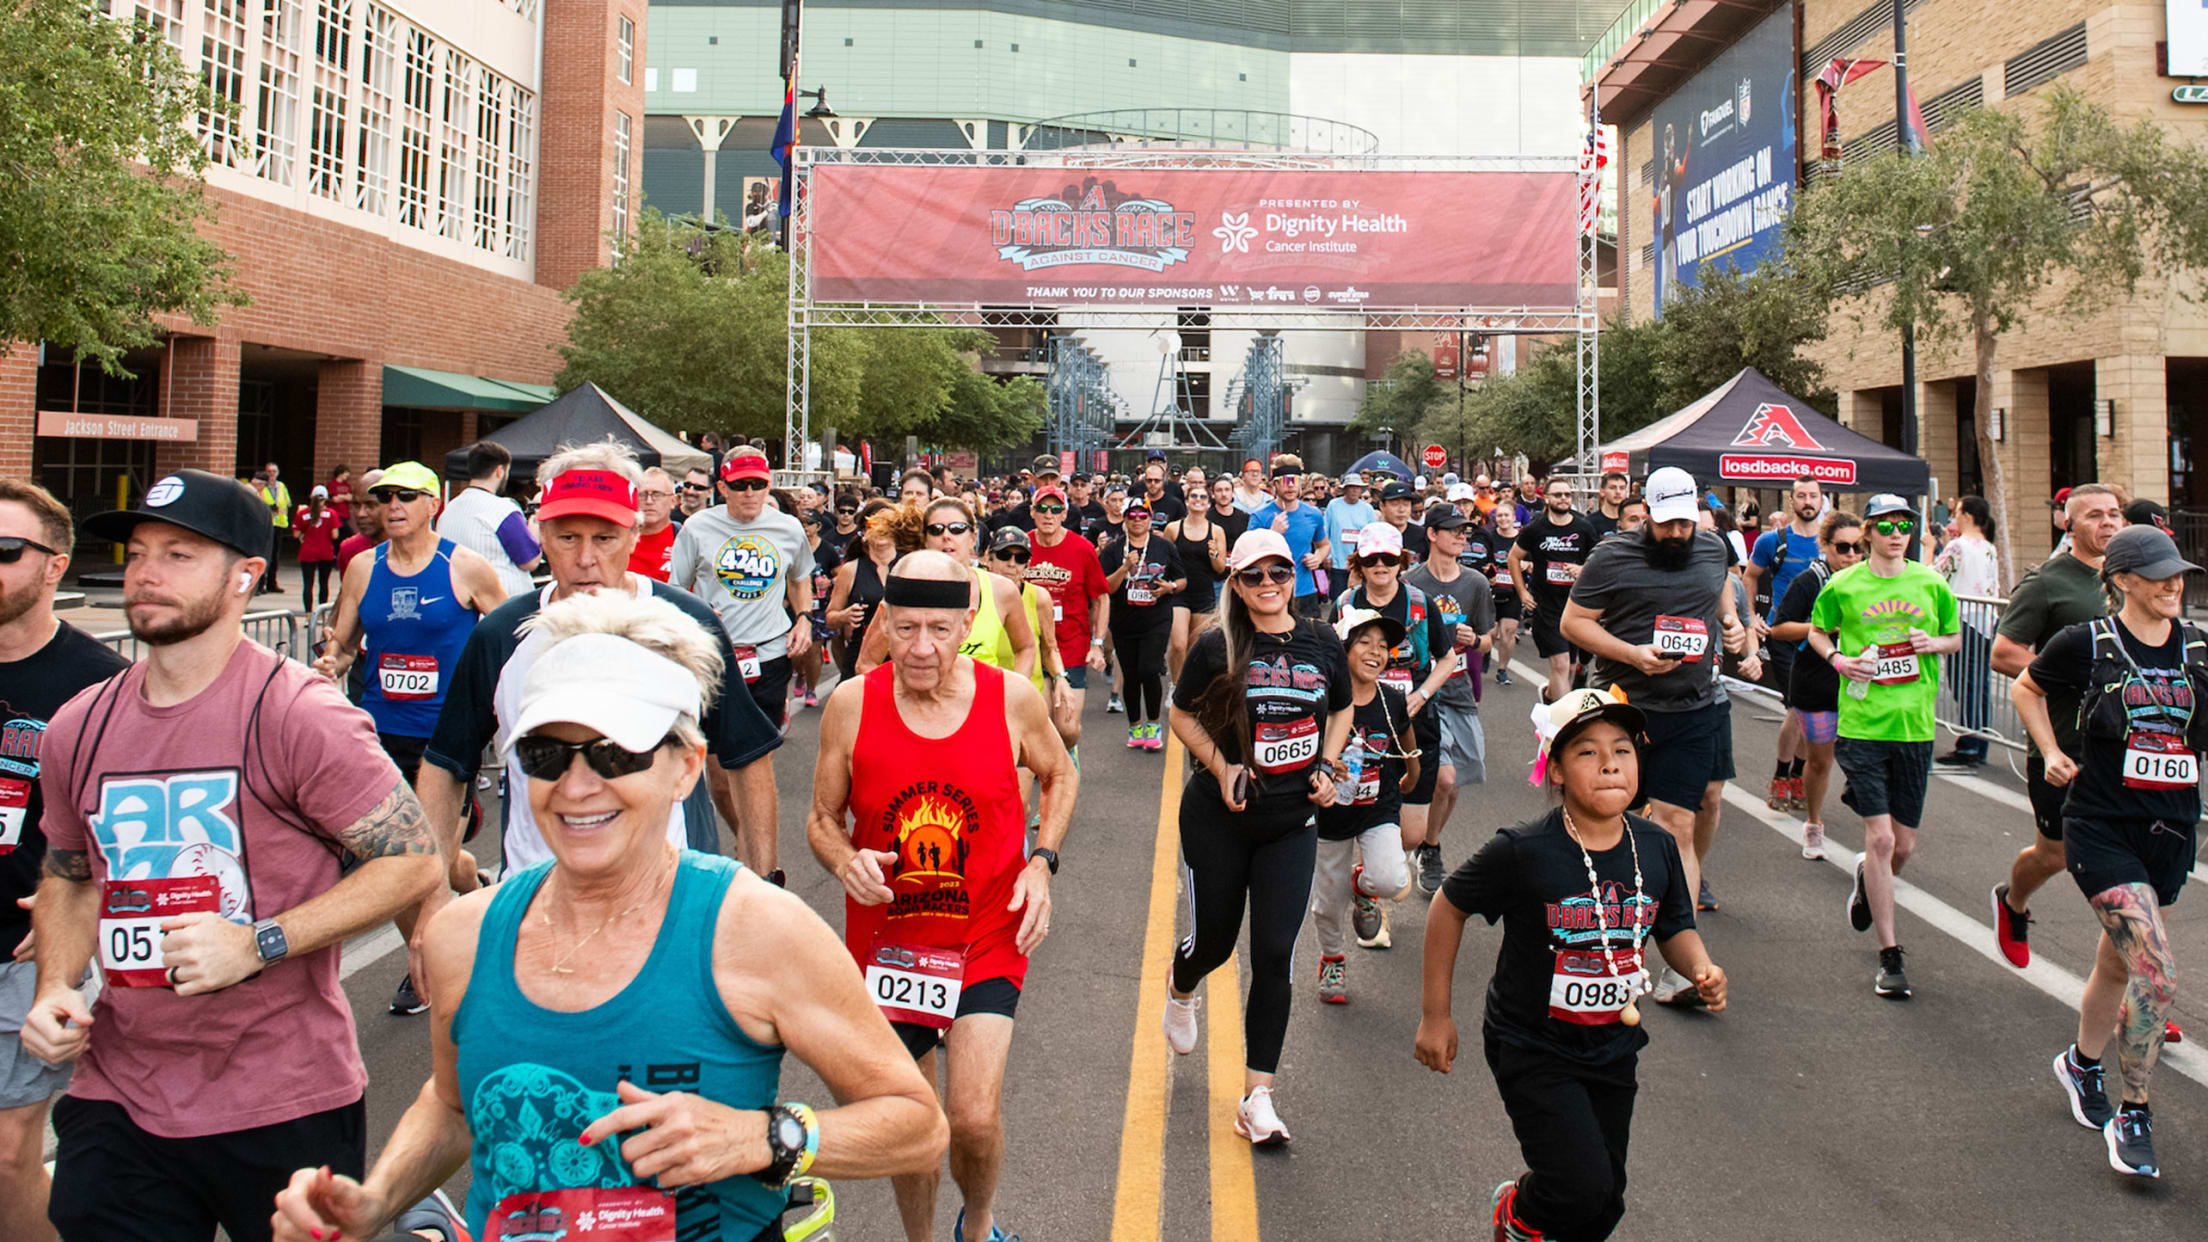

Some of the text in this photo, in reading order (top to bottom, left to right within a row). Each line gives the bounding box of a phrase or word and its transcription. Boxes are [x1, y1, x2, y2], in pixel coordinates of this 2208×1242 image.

[1686, 144, 1772, 225] START WORKING ON
[1259, 199, 1361, 208] PRESENTED BY
[1115, 210, 1195, 248] RACE
[1266, 213, 1407, 237] Dignity Health
[1675, 227, 1698, 267] YOUR
[1697, 199, 1753, 257] TOUCHDOWN
[1265, 240, 1357, 253] Cancer Institute
[1029, 252, 1159, 269] AGAINST CANCER
[1026, 287, 1213, 299] THANK YOU TO OUR SPONSORS
[64, 419, 179, 439] Jackson Street Entrance
[1424, 451, 1445, 461] STOP
[1724, 458, 1851, 479] losdbacks.com
[1661, 634, 1703, 652] 0643
[384, 673, 430, 691] 0702
[1264, 738, 1313, 764] 0665
[2135, 756, 2190, 779] 0160
[882, 781, 980, 834] SUMMER SERIES
[887, 902, 969, 916] ROAD RACERS
[878, 975, 947, 1010] 0213
[598, 1206, 665, 1222] Dignity Health
